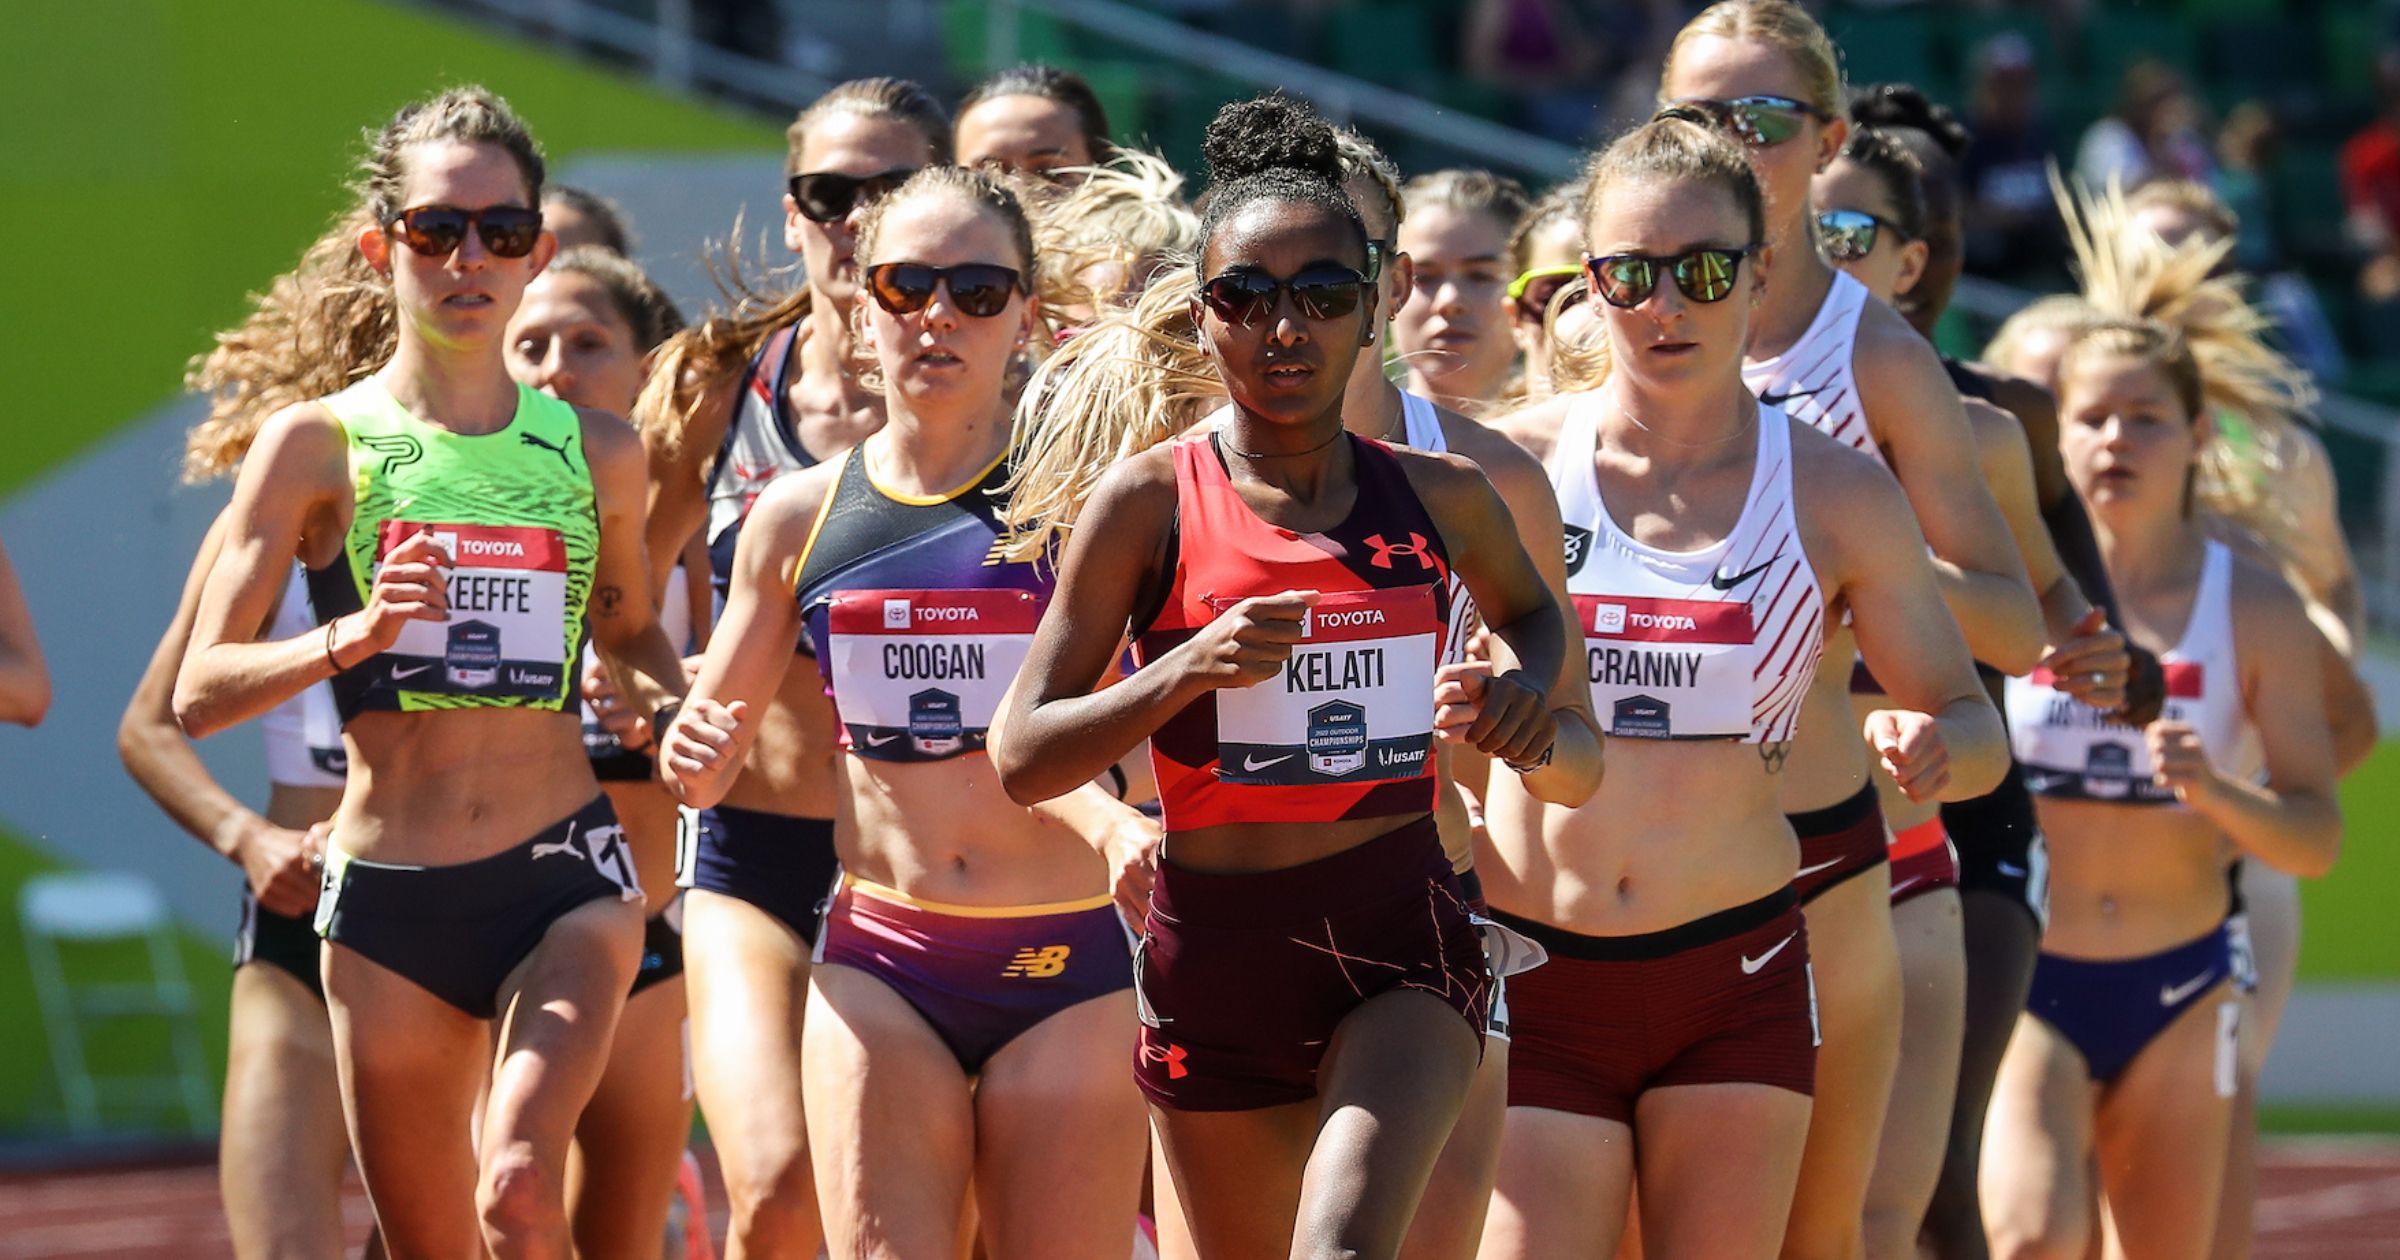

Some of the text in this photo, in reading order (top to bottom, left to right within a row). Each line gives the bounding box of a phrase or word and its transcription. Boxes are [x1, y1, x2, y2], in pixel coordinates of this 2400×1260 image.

[461, 539, 525, 557] TOYOTA
[915, 607, 980, 622] TOYOTA
[1317, 609, 1386, 628] TOYOTA
[1629, 612, 1697, 630] TOYOTA
[882, 642, 986, 680] COOGAN
[1588, 646, 1703, 688] CRANNY
[1286, 647, 1385, 694] KELATI
[1329, 714, 1353, 722] USATF
[1330, 727, 1360, 737] OUTDOOR
[1310, 735, 1365, 748] CHAMPIONSHIPS
[1393, 750, 1426, 764] USATF
